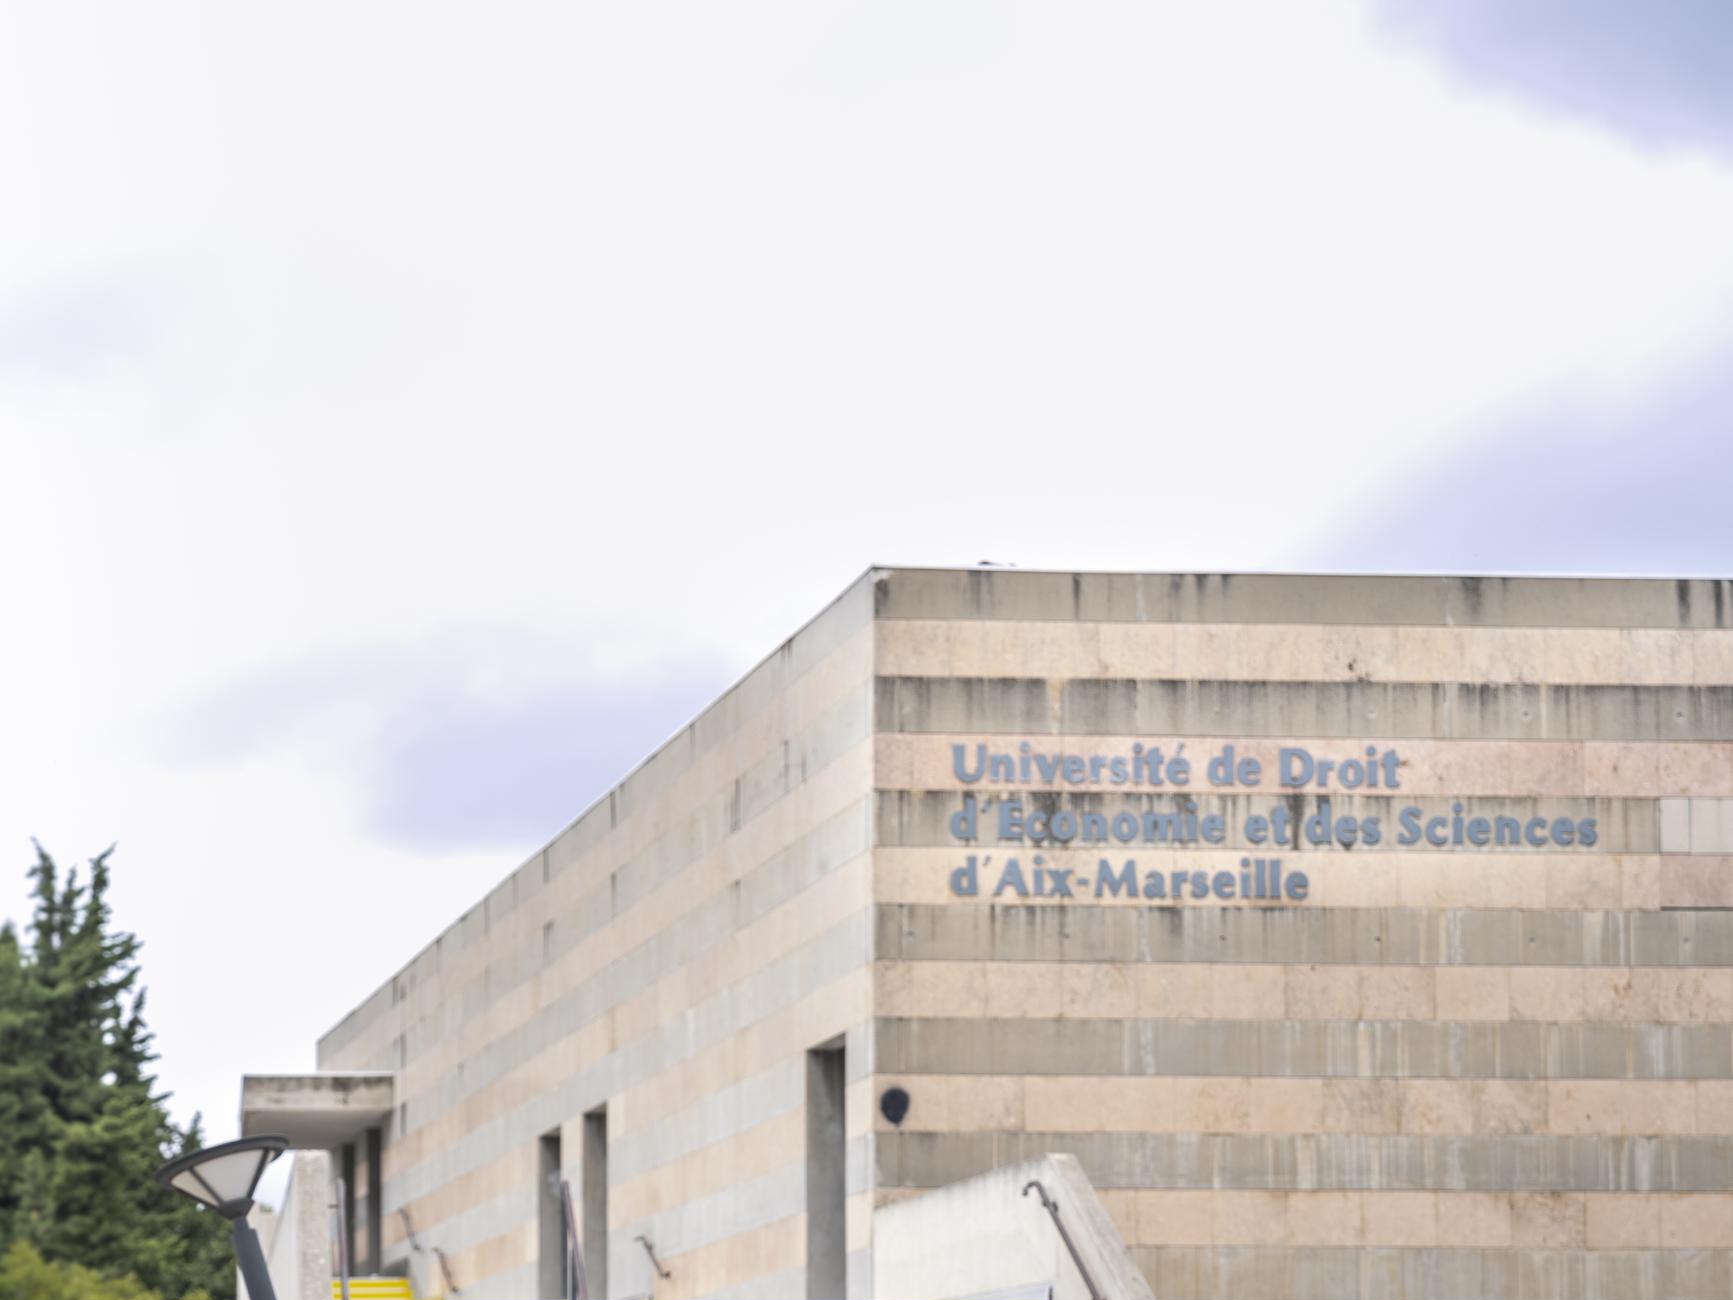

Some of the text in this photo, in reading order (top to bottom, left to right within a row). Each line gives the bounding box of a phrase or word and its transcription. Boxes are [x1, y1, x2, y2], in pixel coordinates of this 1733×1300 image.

[952, 742, 1401, 789] Université de Droit
[1244, 805, 1291, 845] et
[1304, 801, 1382, 846] des
[1397, 801, 1598, 847] Sciences
[950, 855, 1309, 900] d'Aix-Marseille
